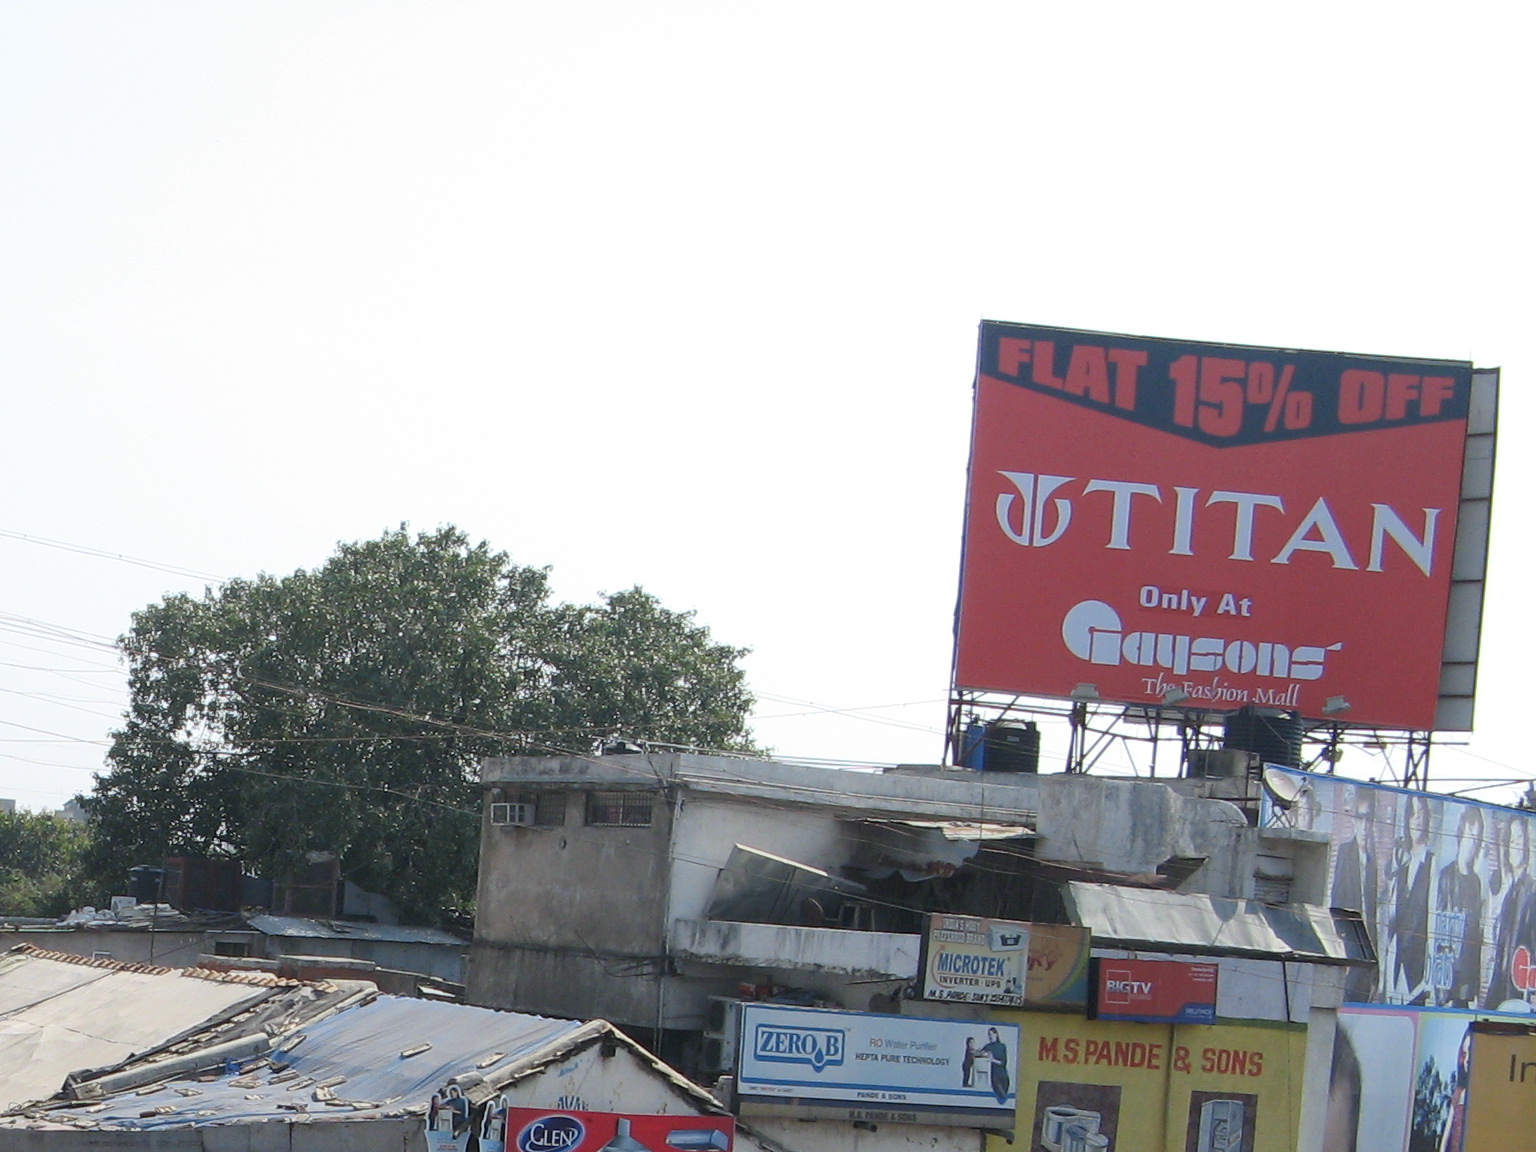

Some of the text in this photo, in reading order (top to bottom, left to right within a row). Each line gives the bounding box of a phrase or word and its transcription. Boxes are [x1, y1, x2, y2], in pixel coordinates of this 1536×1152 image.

[997, 337, 1456, 437] FLAT 15% OFF
[1080, 478, 1442, 578] TITAN
[1139, 584, 1252, 617] Only At
[1142, 676, 1177, 696] The
[1252, 684, 1301, 706] Mall
[937, 953, 1005, 977] MICROTEK
[939, 976, 980, 987] INVERTER
[760, 1030, 840, 1056] ZERO B
[880, 1053, 901, 1064] PURE
[1173, 1046, 1192, 1074] &
[1201, 1047, 1264, 1077] SONS
[530, 1122, 576, 1148] GLEN
